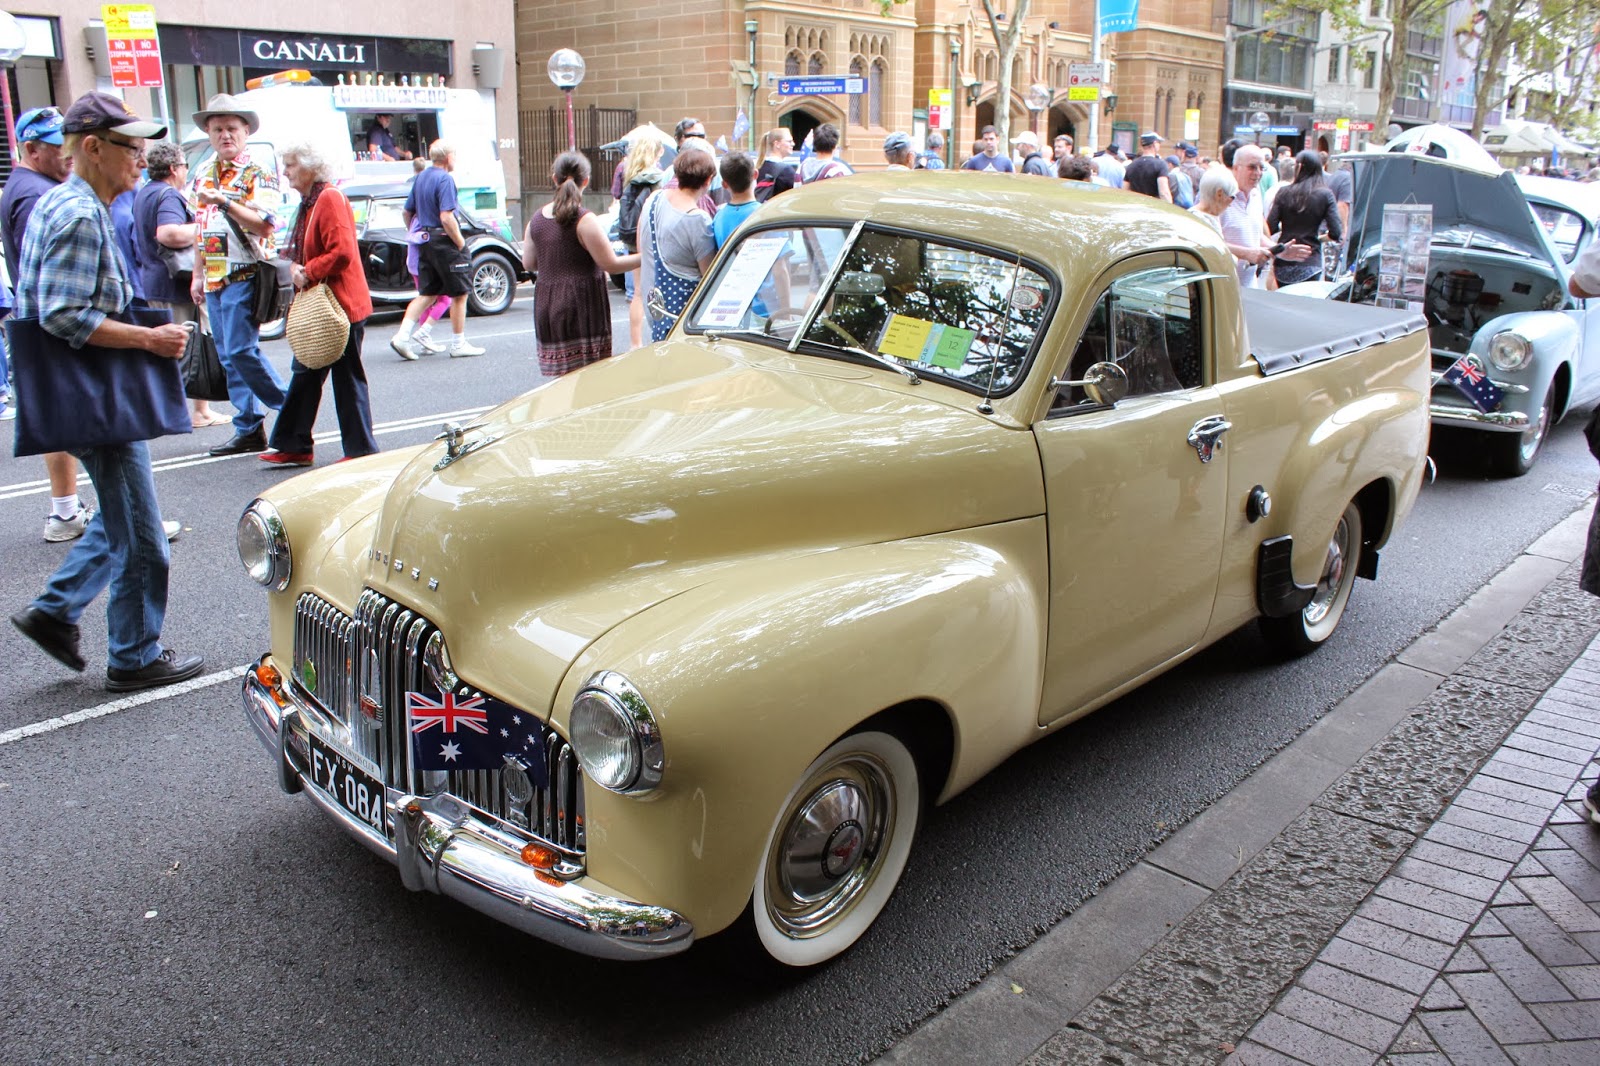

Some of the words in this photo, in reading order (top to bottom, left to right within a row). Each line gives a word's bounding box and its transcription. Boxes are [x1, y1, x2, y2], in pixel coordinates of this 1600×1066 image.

[114, 41, 126, 50] NO
[140, 40, 152, 49] NO
[110, 50, 134, 58] STOPPING
[253, 40, 365, 63] CANALI
[499, 138, 515, 149] 201
[948, 341, 959, 351] 12
[335, 754, 354, 774] NSW
